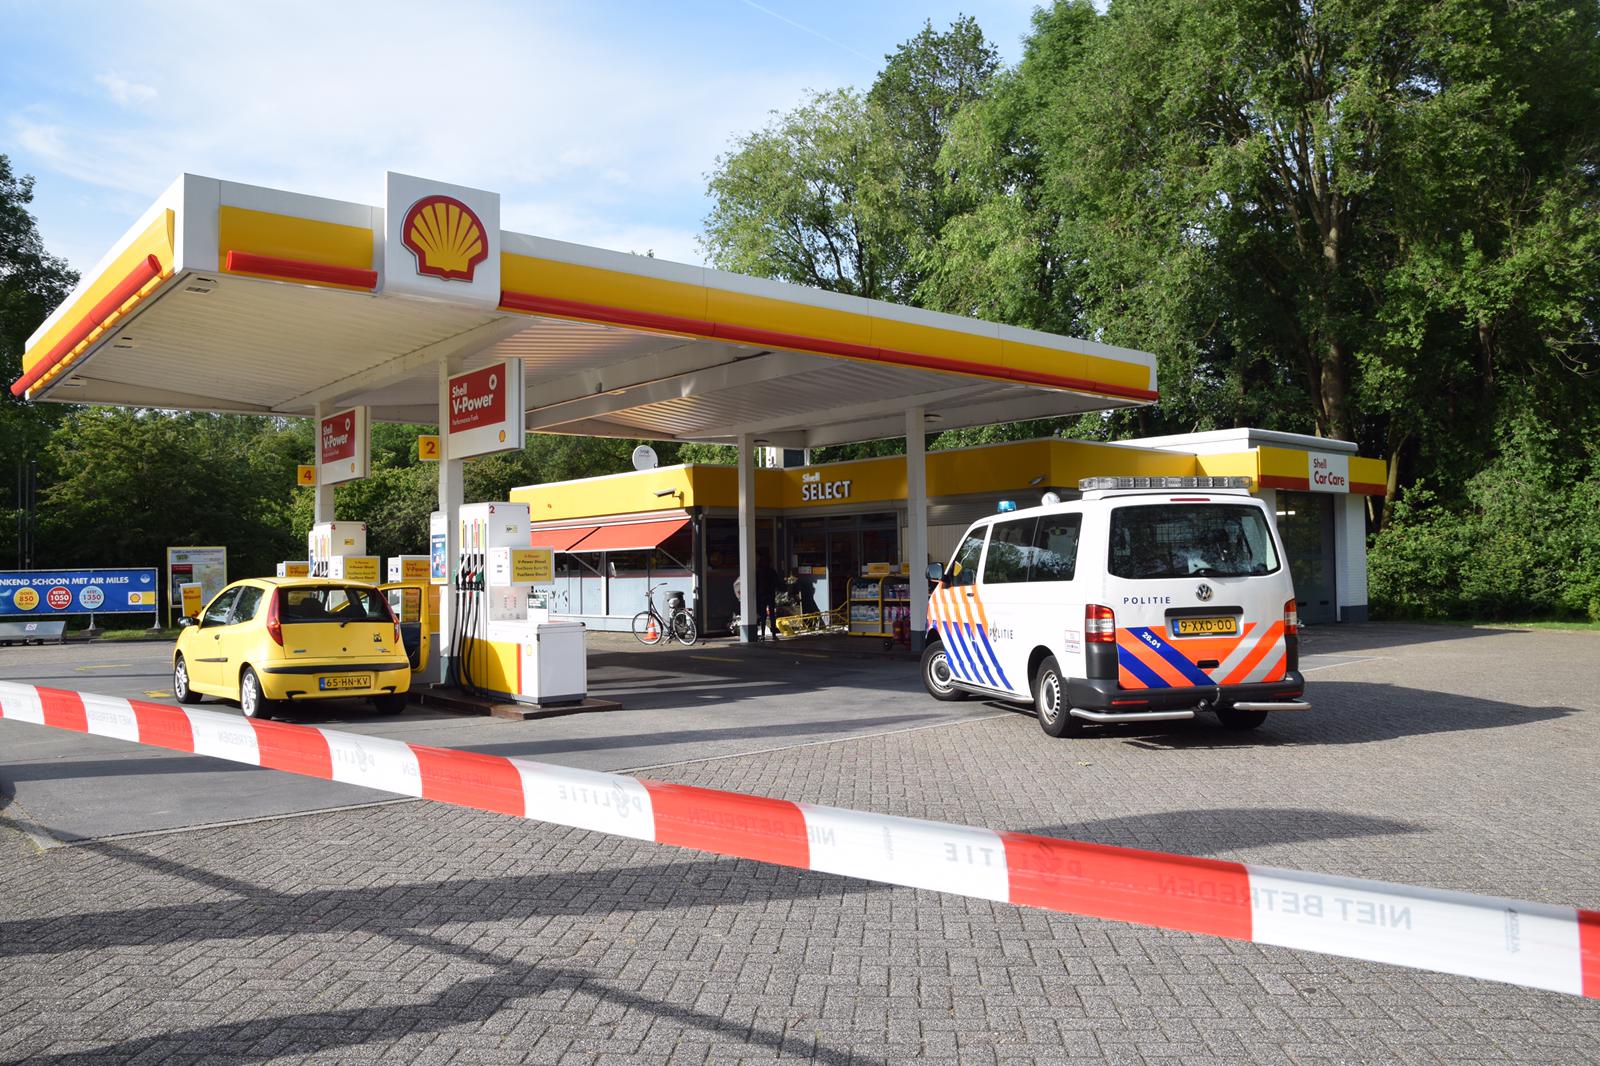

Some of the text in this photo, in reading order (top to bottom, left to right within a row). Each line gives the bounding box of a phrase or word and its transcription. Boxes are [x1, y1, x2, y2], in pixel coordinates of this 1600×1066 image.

[452, 383, 468, 398] Shell
[453, 394, 494, 415] V-Power
[323, 423, 333, 436] Shell
[323, 433, 348, 449] V-Power
[426, 441, 436, 455] 2
[1313, 458, 1328, 469] Shell
[303, 471, 312, 481] 4
[802, 472, 820, 483] Shell
[1314, 471, 1345, 486] Car Care
[802, 480, 850, 501] SELECT
[489, 505, 495, 514] 2
[330, 523, 336, 531] 4
[361, 523, 367, 531] 3
[106, 576, 129, 584] MILES
[1123, 596, 1171, 605] POLITIE
[1180, 619, 1232, 632] 9-XXD-00
[326, 676, 368, 687] 65-HN-KV
